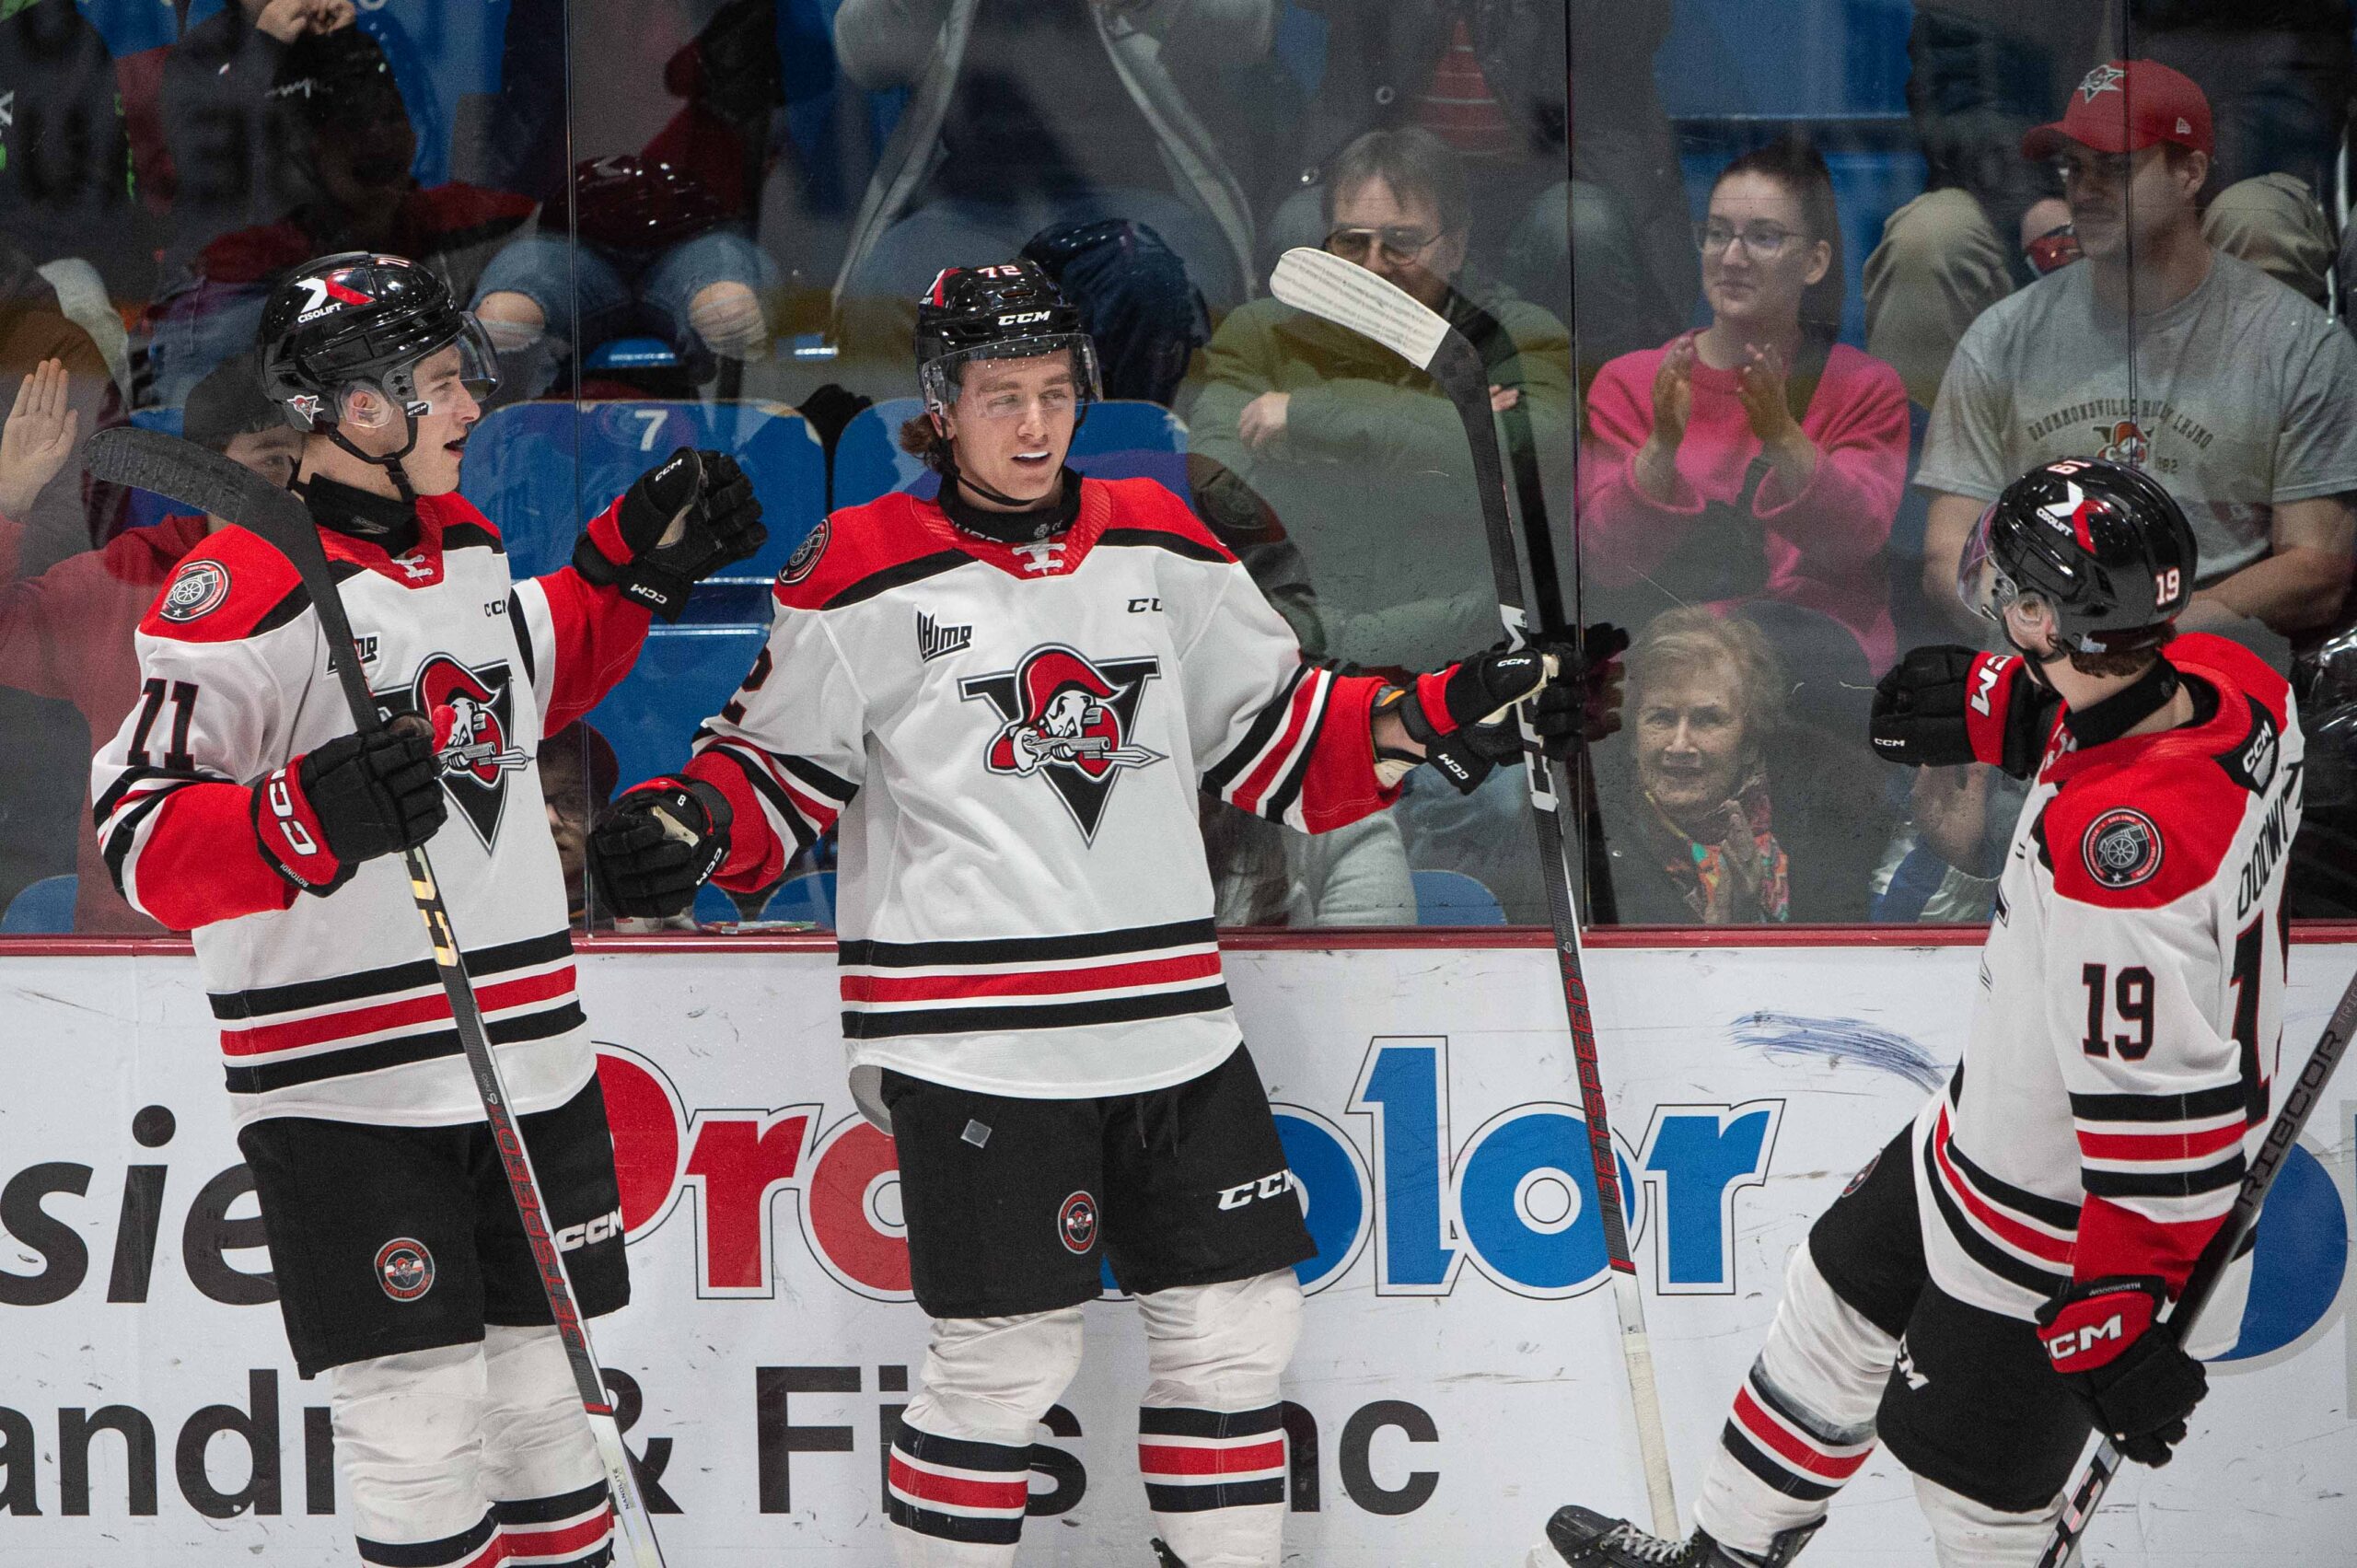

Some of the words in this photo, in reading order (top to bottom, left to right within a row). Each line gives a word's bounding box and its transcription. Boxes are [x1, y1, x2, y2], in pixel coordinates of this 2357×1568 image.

[297, 302, 343, 324] CISOLIFT
[998, 310, 1051, 326] CCM
[634, 409, 669, 451] 7
[655, 458, 683, 482] CCM
[631, 583, 668, 605] CCM
[2155, 567, 2180, 606] 19
[1496, 656, 1531, 668] CCM
[127, 678, 199, 771] 71
[1874, 738, 1905, 748] CCM
[1437, 752, 1469, 781] CCM
[2242, 720, 2272, 774] CCM
[695, 847, 722, 887] CCM
[2082, 962, 2155, 1061] 19
[1566, 977, 1620, 1203] JETSPEED
[2237, 1028, 2343, 1208] RIBCOR
[497, 1126, 586, 1351] JETSPEED
[2043, 1314, 2122, 1361] CM
